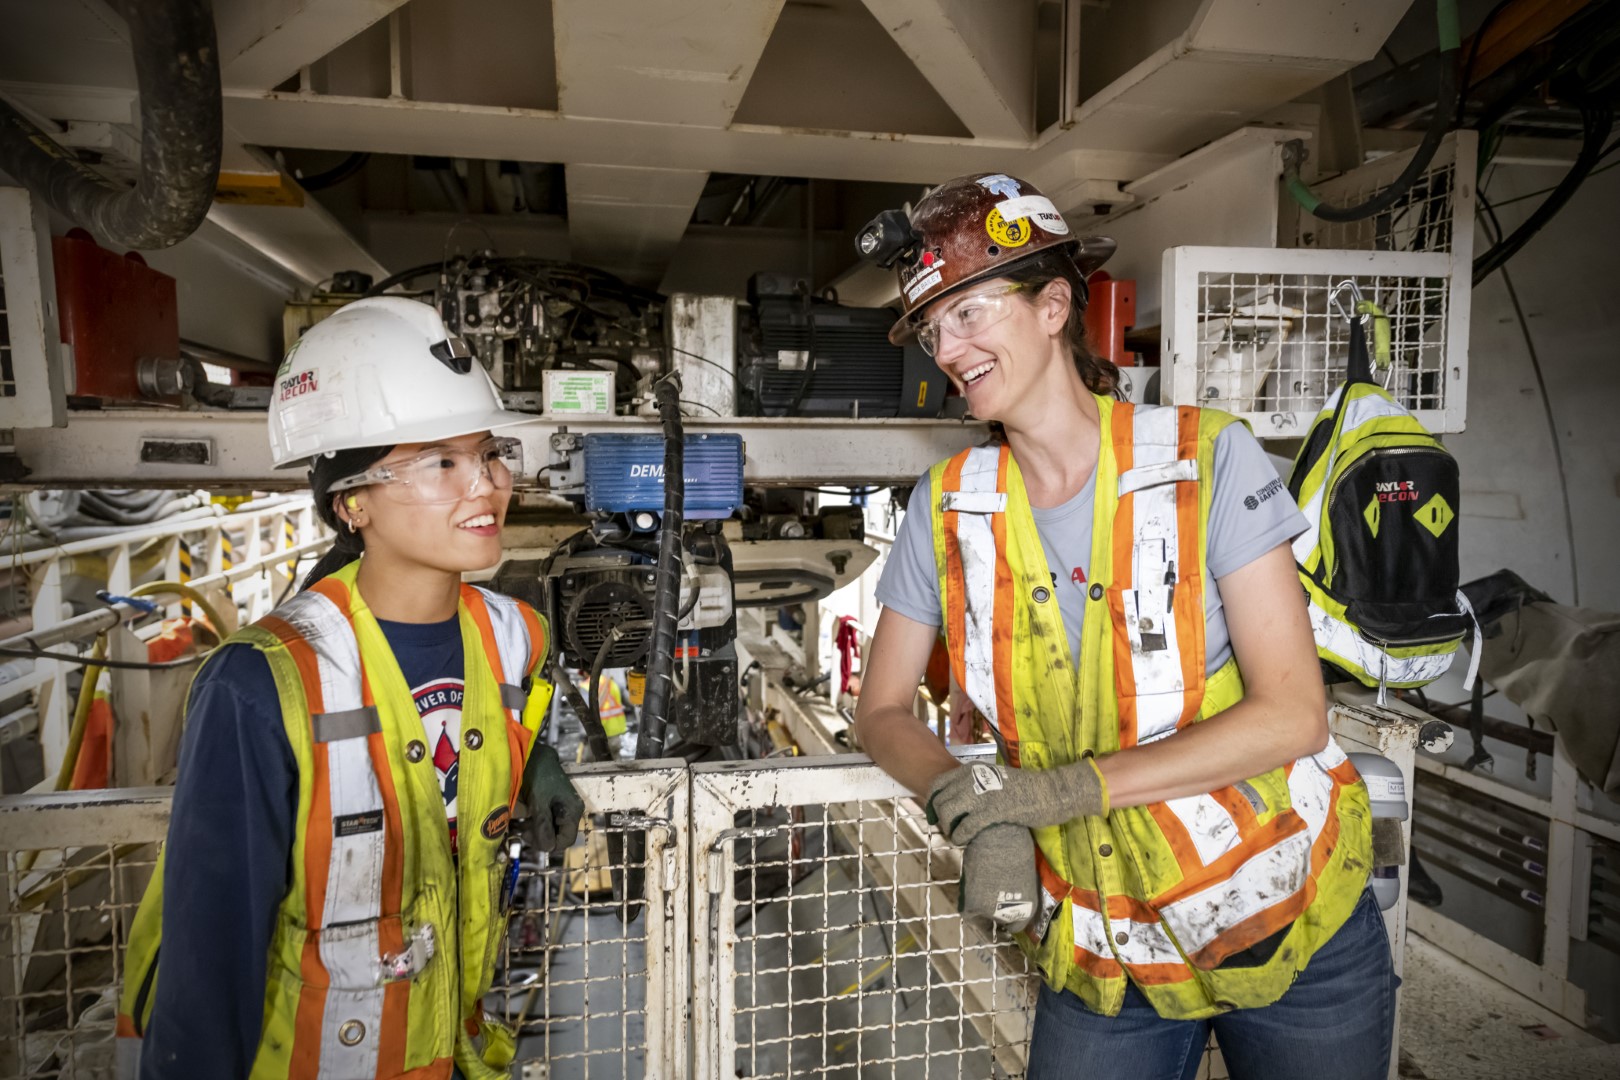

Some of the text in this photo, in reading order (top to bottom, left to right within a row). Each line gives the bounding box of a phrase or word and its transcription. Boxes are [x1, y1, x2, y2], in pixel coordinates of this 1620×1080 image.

[630, 464, 666, 478] DEM
[1256, 477, 1283, 497] CONSTRU
[1259, 483, 1284, 503] SAFETY
[1376, 480, 1415, 492] RAYLOR
[415, 691, 447, 713] IVER
